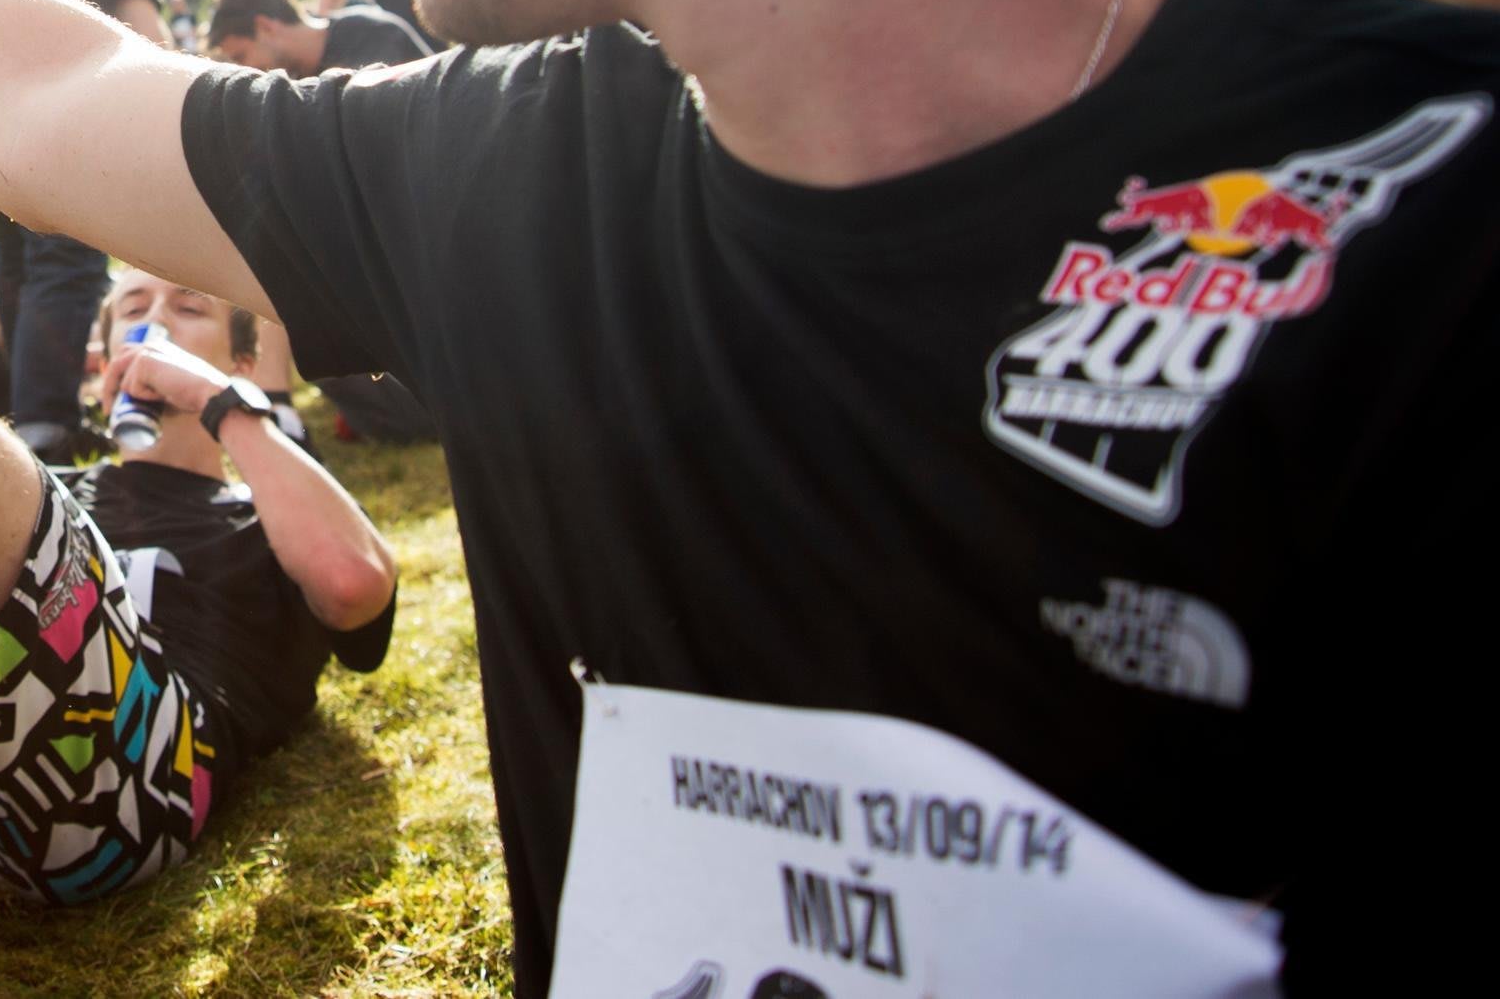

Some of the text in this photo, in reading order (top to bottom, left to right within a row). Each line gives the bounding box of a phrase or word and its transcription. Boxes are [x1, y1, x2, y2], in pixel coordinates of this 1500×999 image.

[1040, 243, 1334, 321] Red Bull
[1008, 302, 1258, 394] 400
[671, 756, 1073, 875] HARRACHOV 13/09/14
[780, 858, 903, 978] MUŽI
